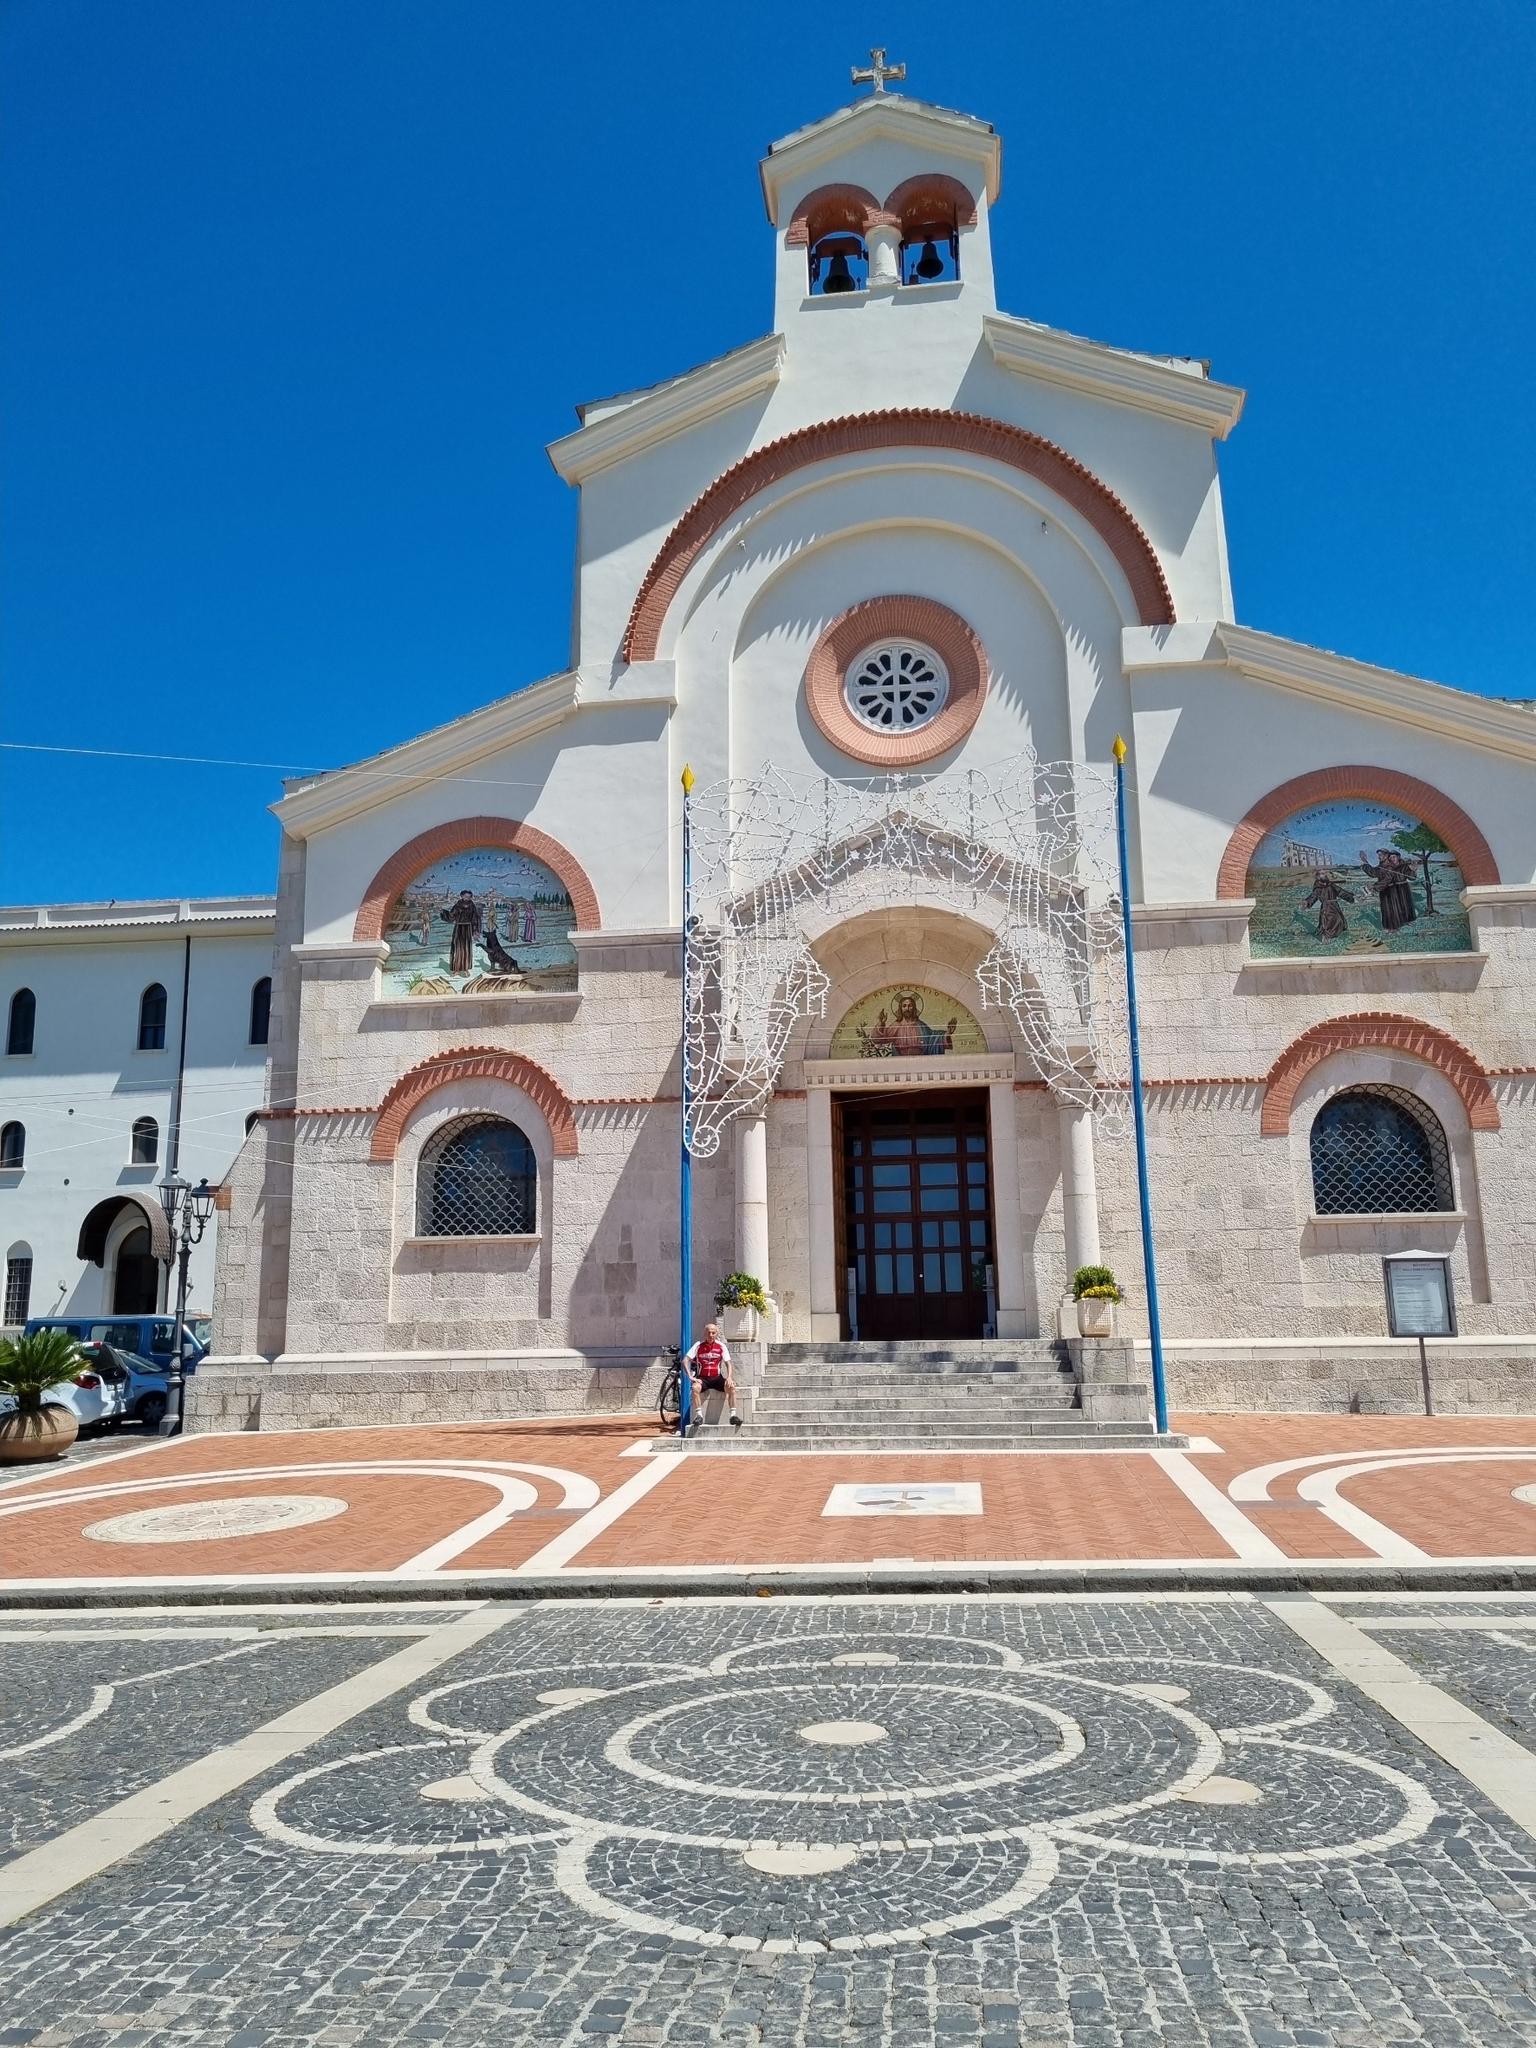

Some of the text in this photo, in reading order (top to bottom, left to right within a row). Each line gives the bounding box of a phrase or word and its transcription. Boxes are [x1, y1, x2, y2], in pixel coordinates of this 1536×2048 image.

[1280, 829, 1290, 837] IL
[1296, 807, 1336, 825] SIGNORE
[1345, 805, 1355, 813] TI
[422, 872, 437, 887] NON
